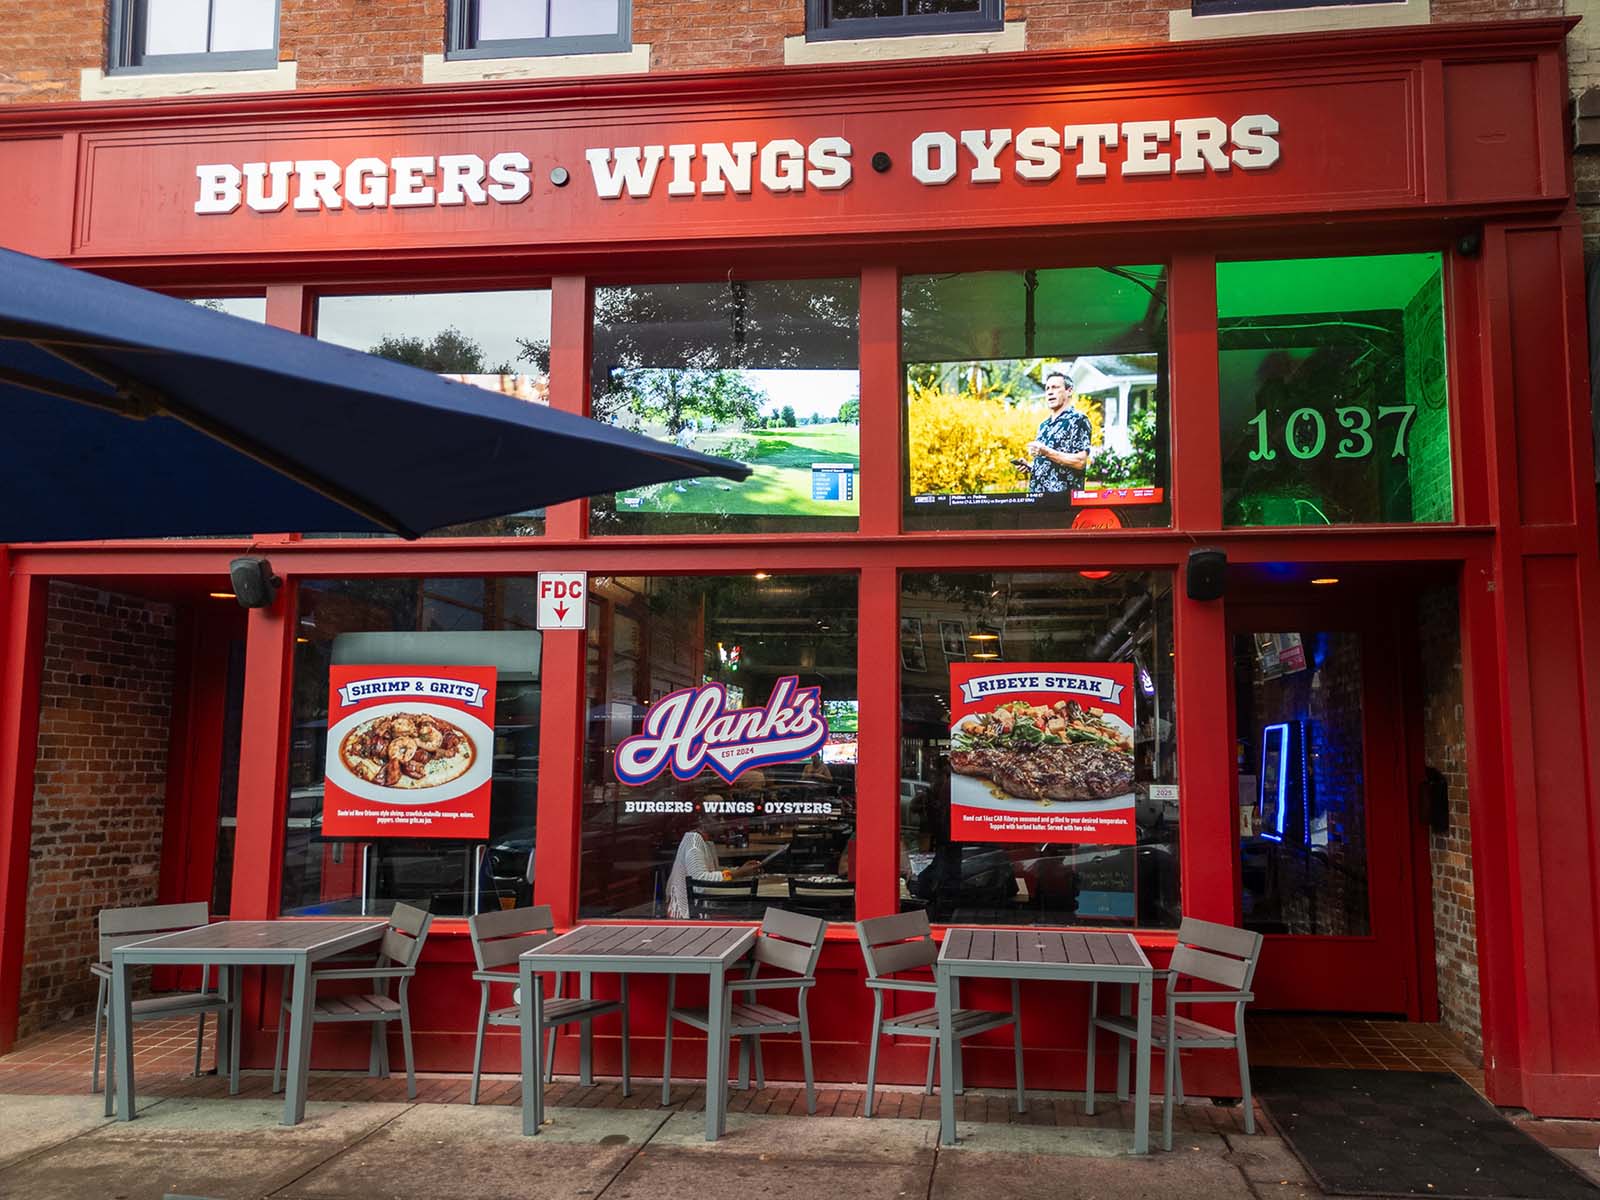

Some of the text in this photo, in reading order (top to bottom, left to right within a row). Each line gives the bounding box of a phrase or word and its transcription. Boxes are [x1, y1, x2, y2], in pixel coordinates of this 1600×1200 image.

[194, 114, 1280, 215] BURGERS WINGS OYSTERS
[1248, 405, 1416, 461] 1037
[541, 580, 582, 599] FDC
[351, 681, 475, 697] SHRIMP & GRITS
[977, 677, 1102, 692] RIBEYE STEAK
[616, 676, 827, 784] Hank's
[721, 747, 755, 758] EST 2024
[625, 801, 832, 814] BURGERS WINGS OYSTERS
[990, 823, 1006, 831] Topped
[1004, 816, 1018, 824] Ribeye
